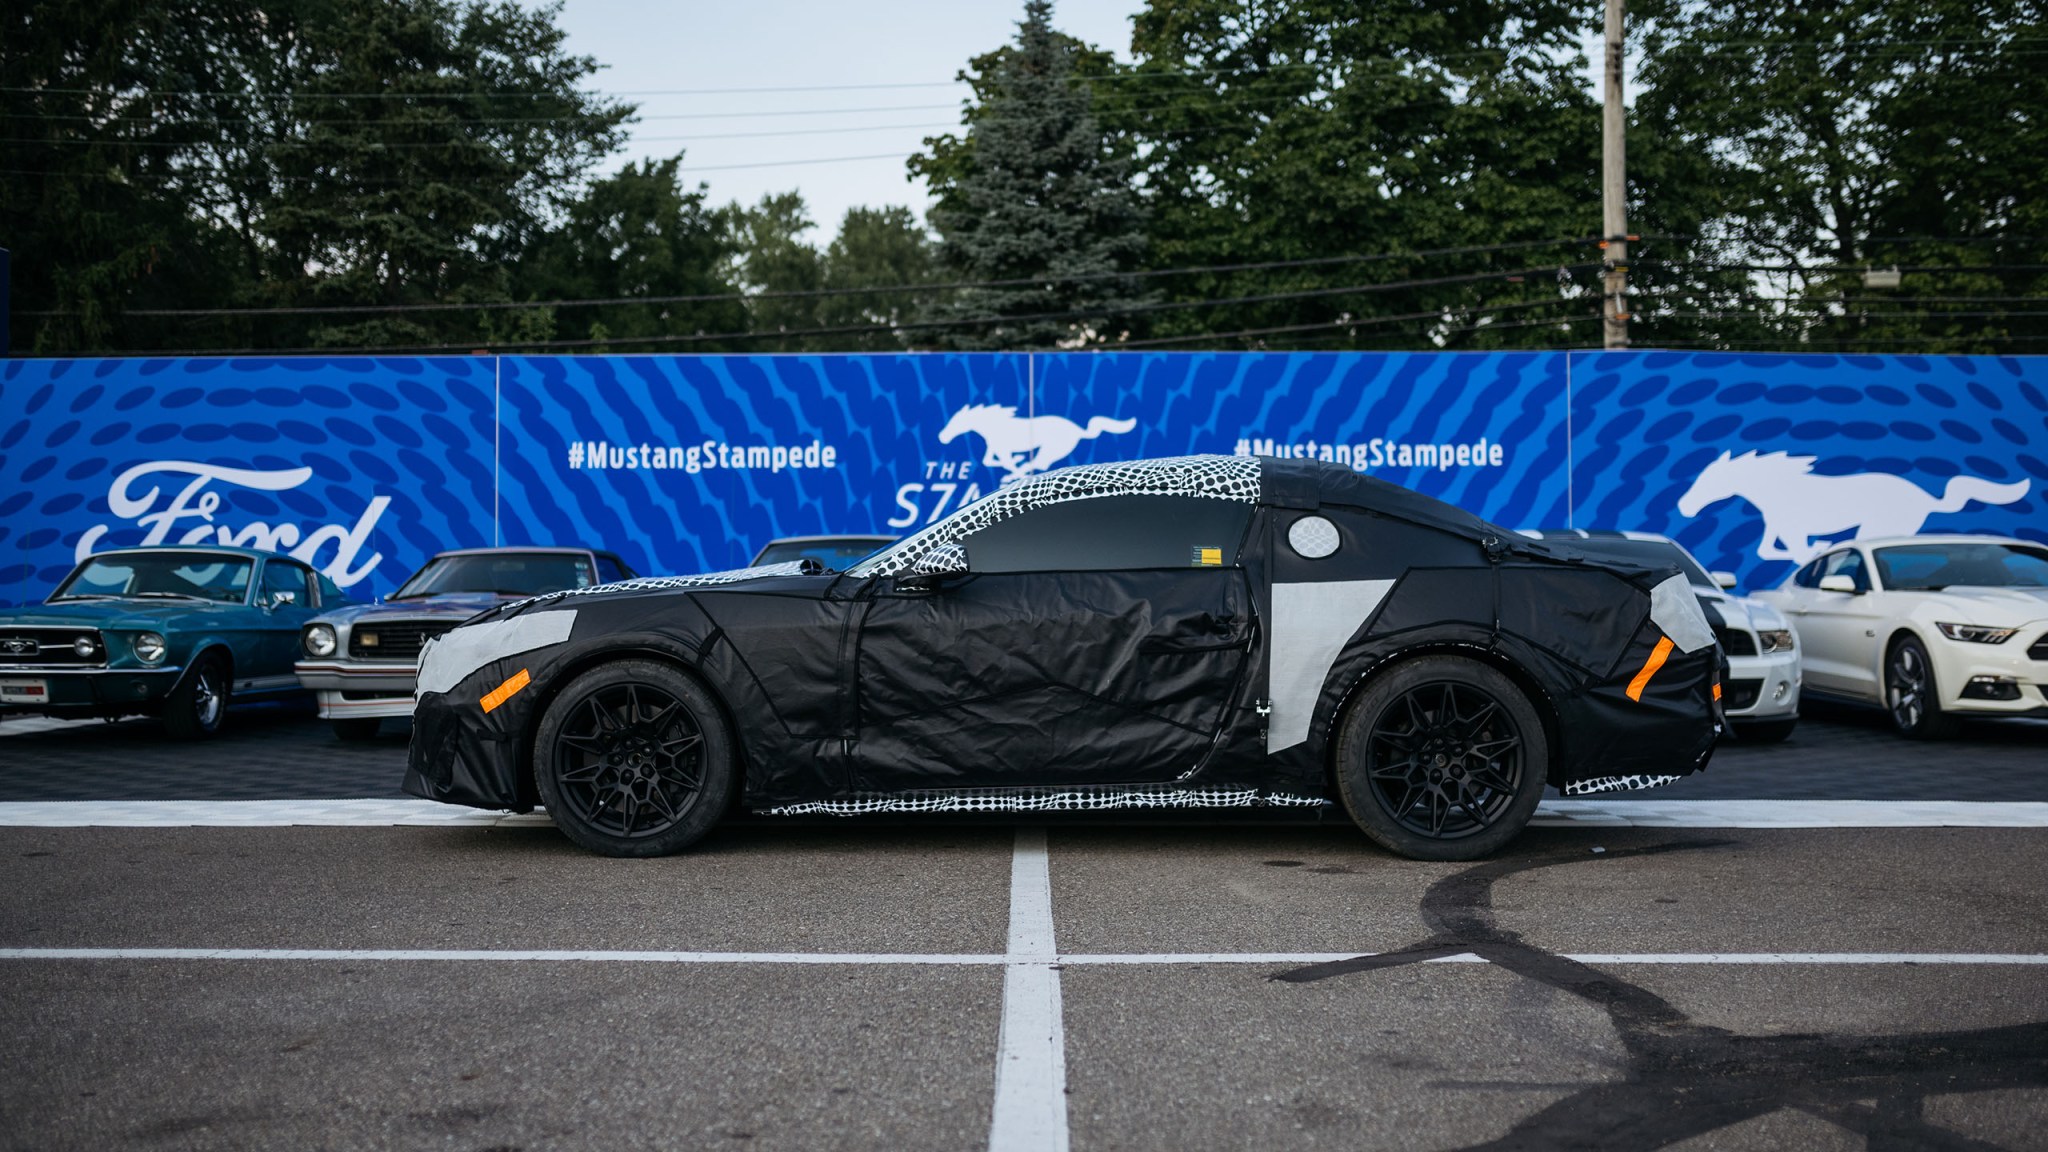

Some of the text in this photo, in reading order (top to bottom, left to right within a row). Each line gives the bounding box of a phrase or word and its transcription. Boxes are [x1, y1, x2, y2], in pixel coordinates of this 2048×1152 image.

[568, 440, 836, 474] #MustangStampede
[926, 461, 972, 480] THE
[75, 460, 392, 588] Ford
